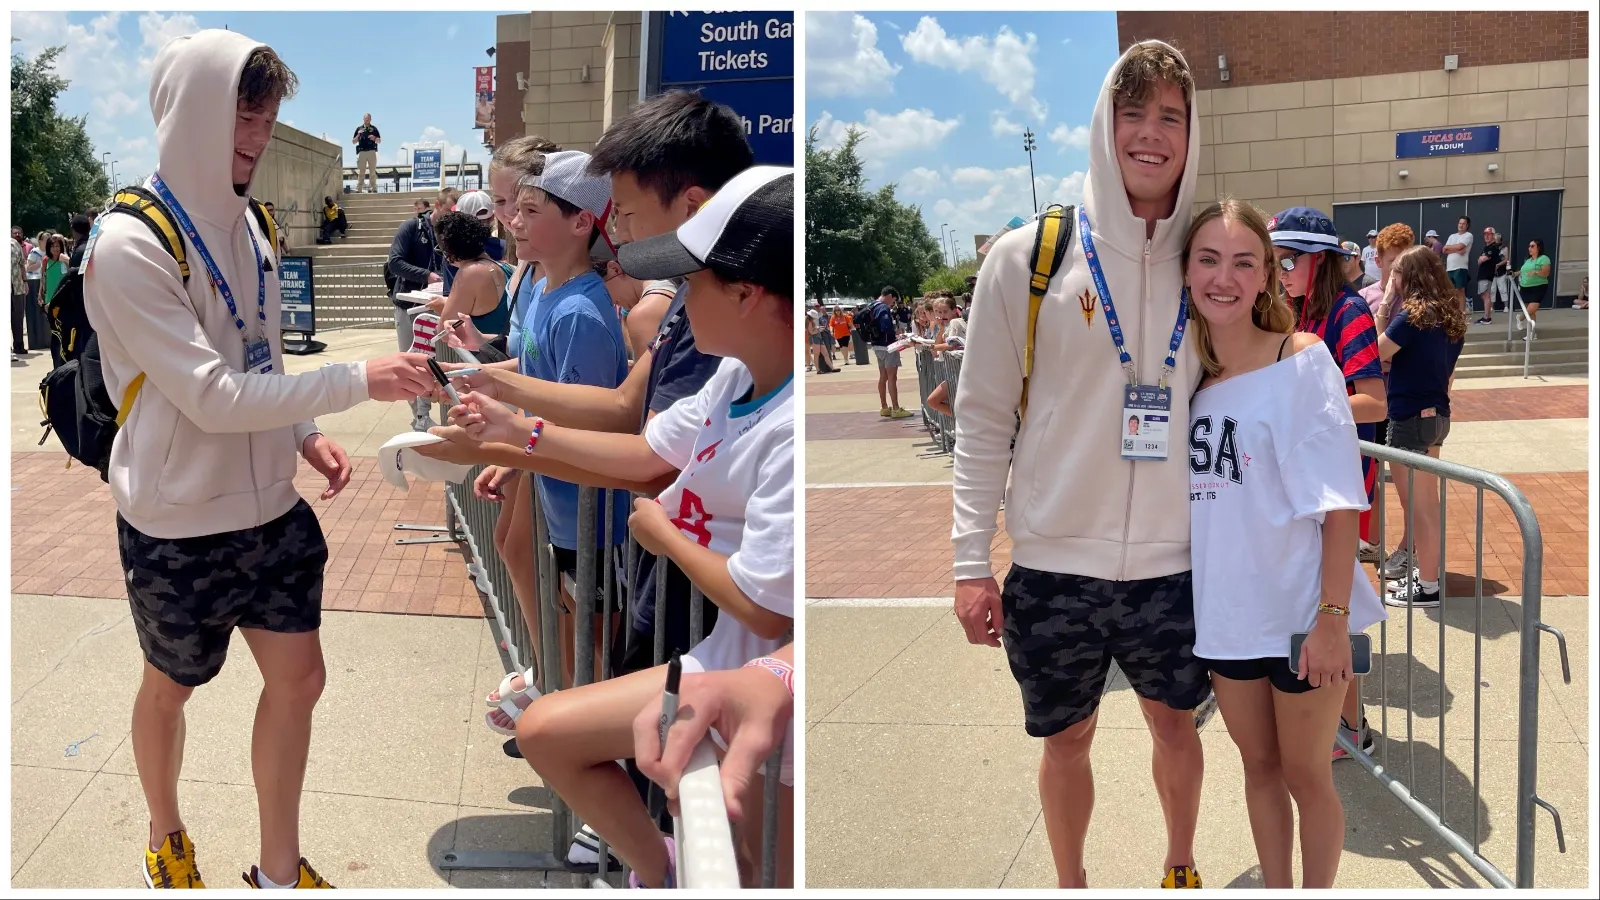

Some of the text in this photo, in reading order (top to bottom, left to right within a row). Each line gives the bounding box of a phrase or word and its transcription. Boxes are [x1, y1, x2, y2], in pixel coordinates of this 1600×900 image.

[700, 20, 759, 43] South
[698, 49, 768, 71] Tickets
[1421, 132, 1472, 144] LUCAS OIL
[283, 271, 298, 280] TEAM
